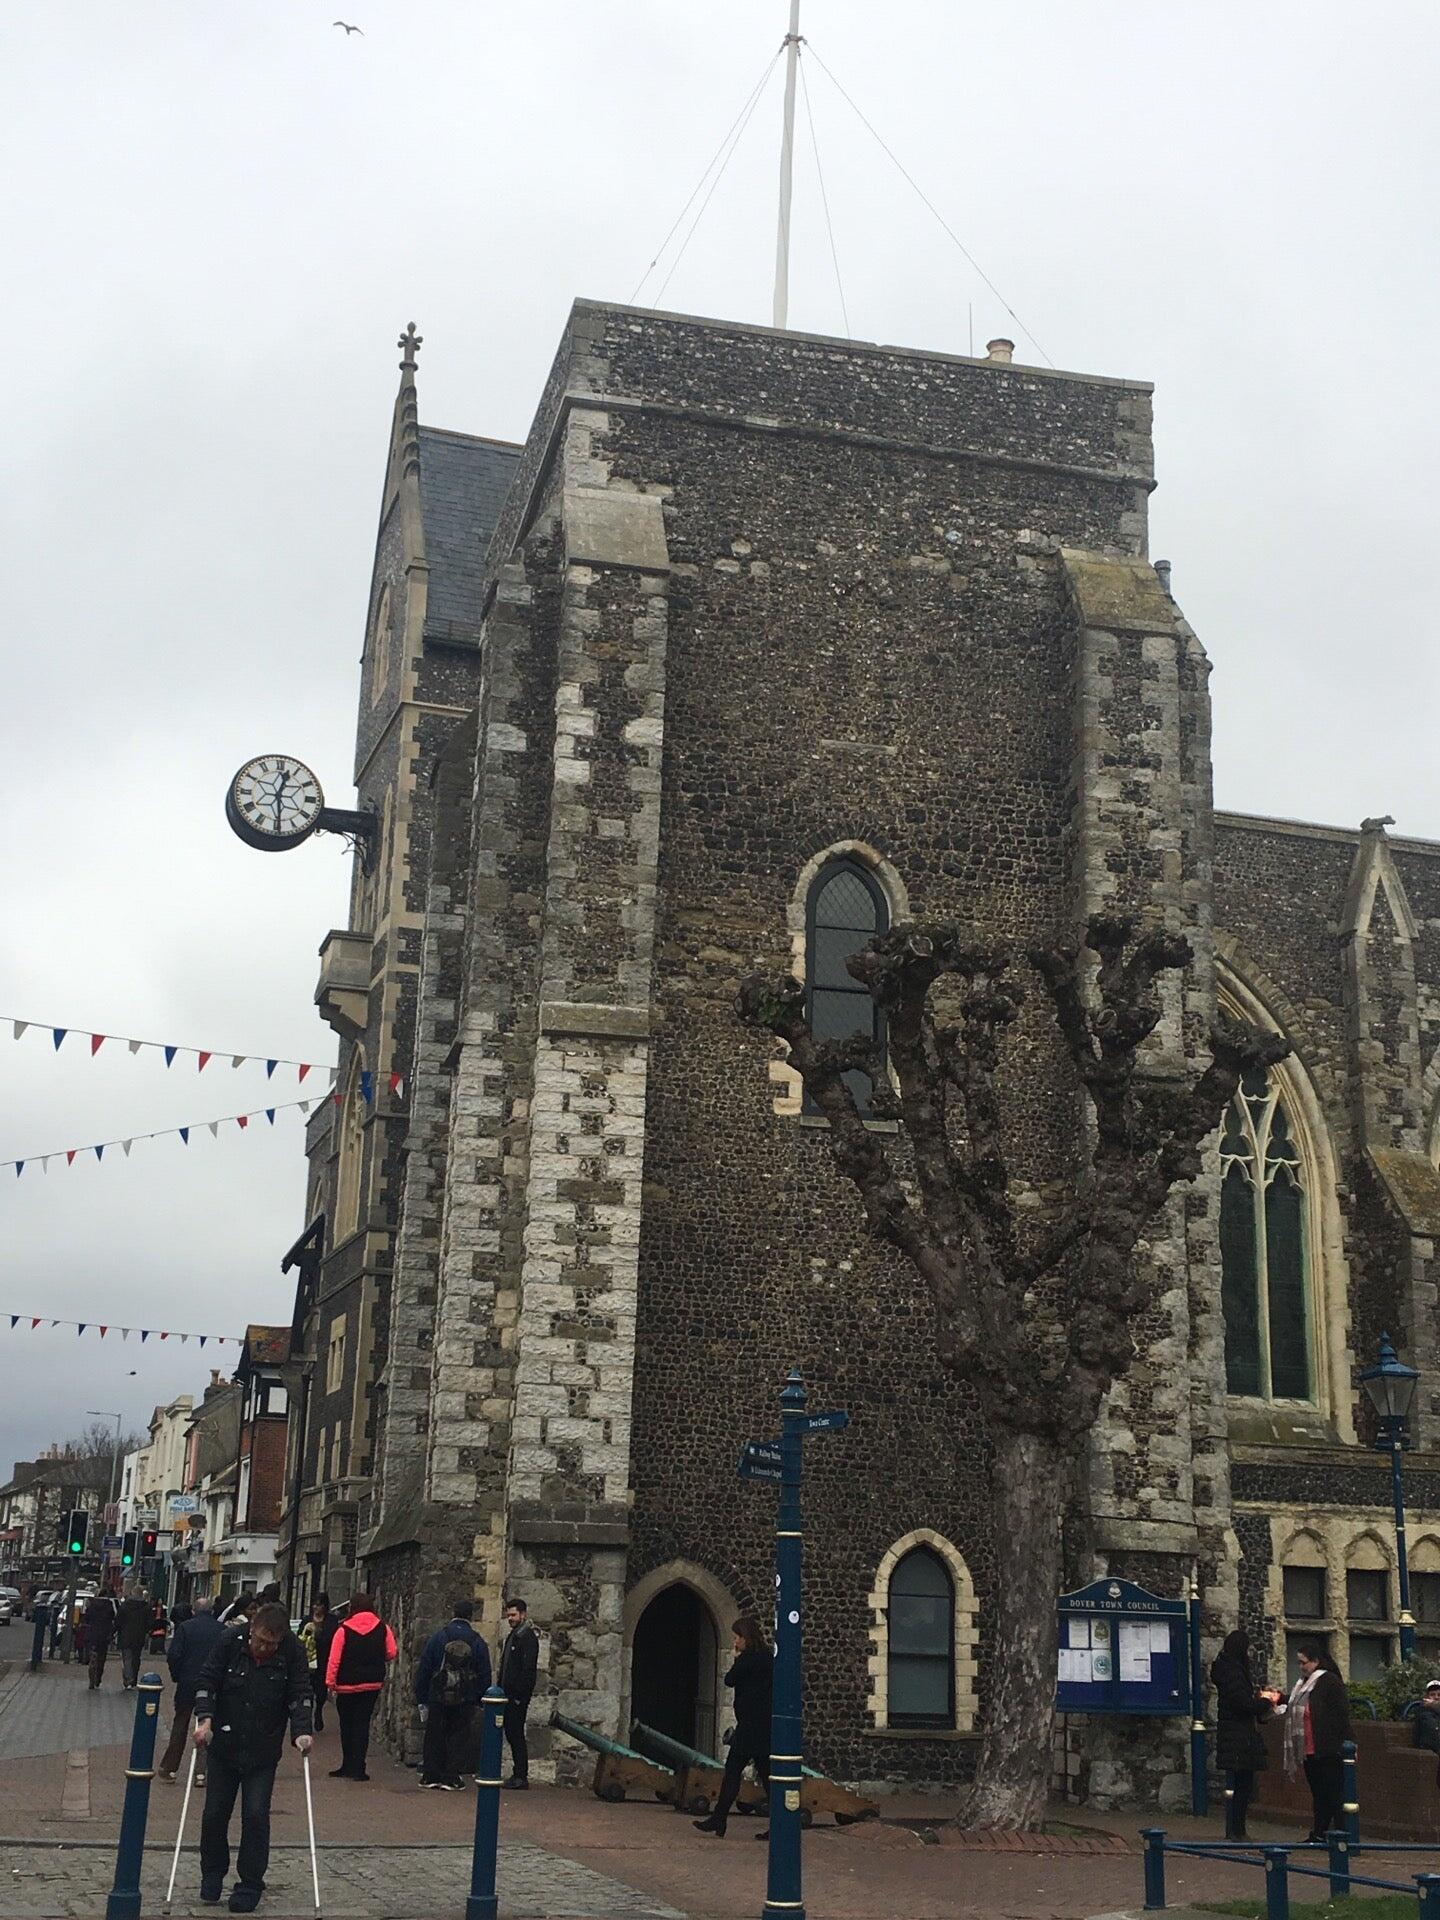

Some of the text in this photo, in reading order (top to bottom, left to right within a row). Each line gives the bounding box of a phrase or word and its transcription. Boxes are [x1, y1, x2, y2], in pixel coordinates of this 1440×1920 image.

[1070, 1599, 1160, 1610] DOVER TOWN COUNCIL
